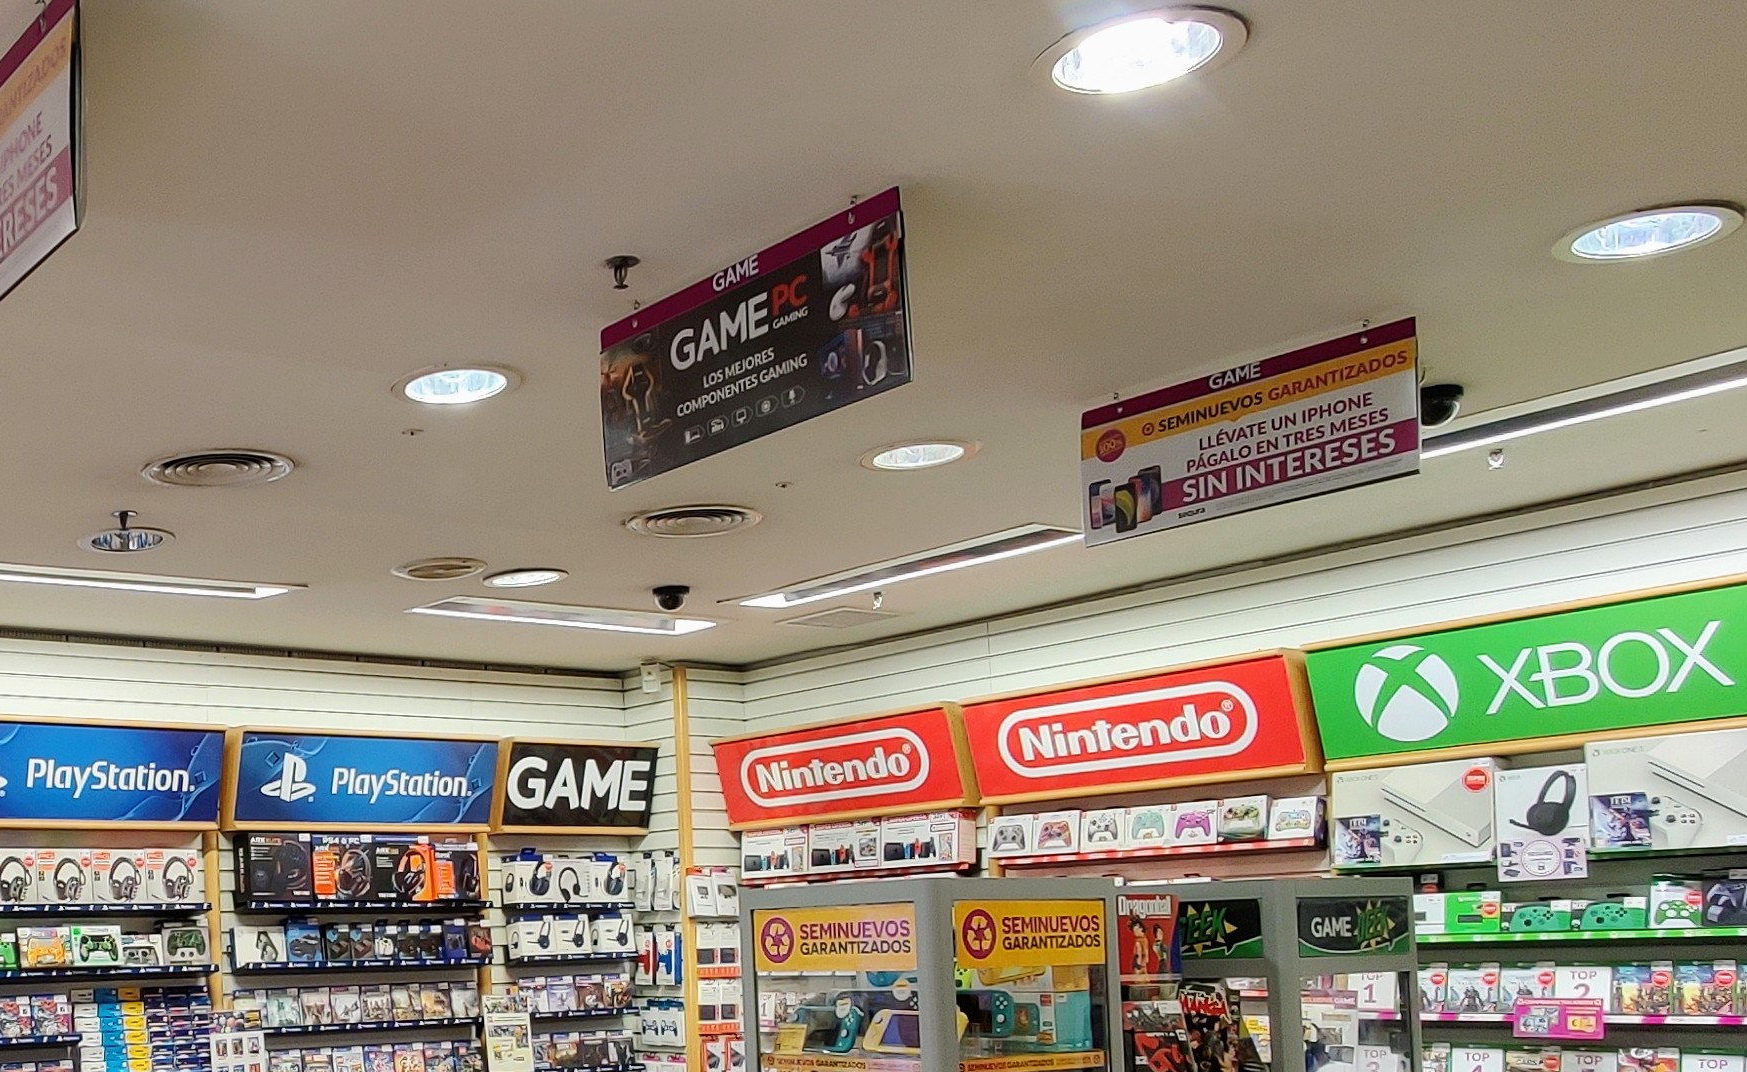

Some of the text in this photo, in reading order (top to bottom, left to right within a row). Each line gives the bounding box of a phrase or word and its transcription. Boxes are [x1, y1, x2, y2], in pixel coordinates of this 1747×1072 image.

[0, 112, 43, 178] IPHONE
[16, 135, 53, 190] MESES
[712, 254, 760, 292] GAME
[670, 274, 808, 371] GAME PC
[772, 305, 809, 331] GAMING
[676, 353, 808, 417] COMPONENTES GAMING
[703, 347, 775, 388] LOS MEJORES
[1208, 361, 1261, 390] GAME
[1157, 350, 1408, 432] SEMINUEVOS GARANTIZADOS
[1186, 408, 1389, 473] PÁGALO EN TRES MESES
[1199, 391, 1373, 451] LLÉVATE UN IPHONE
[1182, 471, 1228, 503] SIN
[1236, 429, 1396, 491] INTERESES
[1476, 620, 1736, 716] XBOX
[1018, 701, 1232, 762] Nintendo
[27, 758, 195, 799] PlayStation
[331, 767, 472, 804] PlayStation
[507, 756, 652, 812] GAME
[754, 744, 911, 793] Nintendo
[799, 919, 910, 939] SEMINUEVOS
[1001, 914, 1100, 935] SEMINUEVOS
[1001, 933, 1101, 952] GARANTIZADOS
[1311, 916, 1352, 938] GAME
[799, 938, 911, 956] GARANTIZADOS
[1569, 970, 1597, 981] TOP
[1464, 1052, 1491, 1062] TOP
[1575, 1055, 1603, 1065] TOP
[1699, 1059, 1728, 1070] TOP
